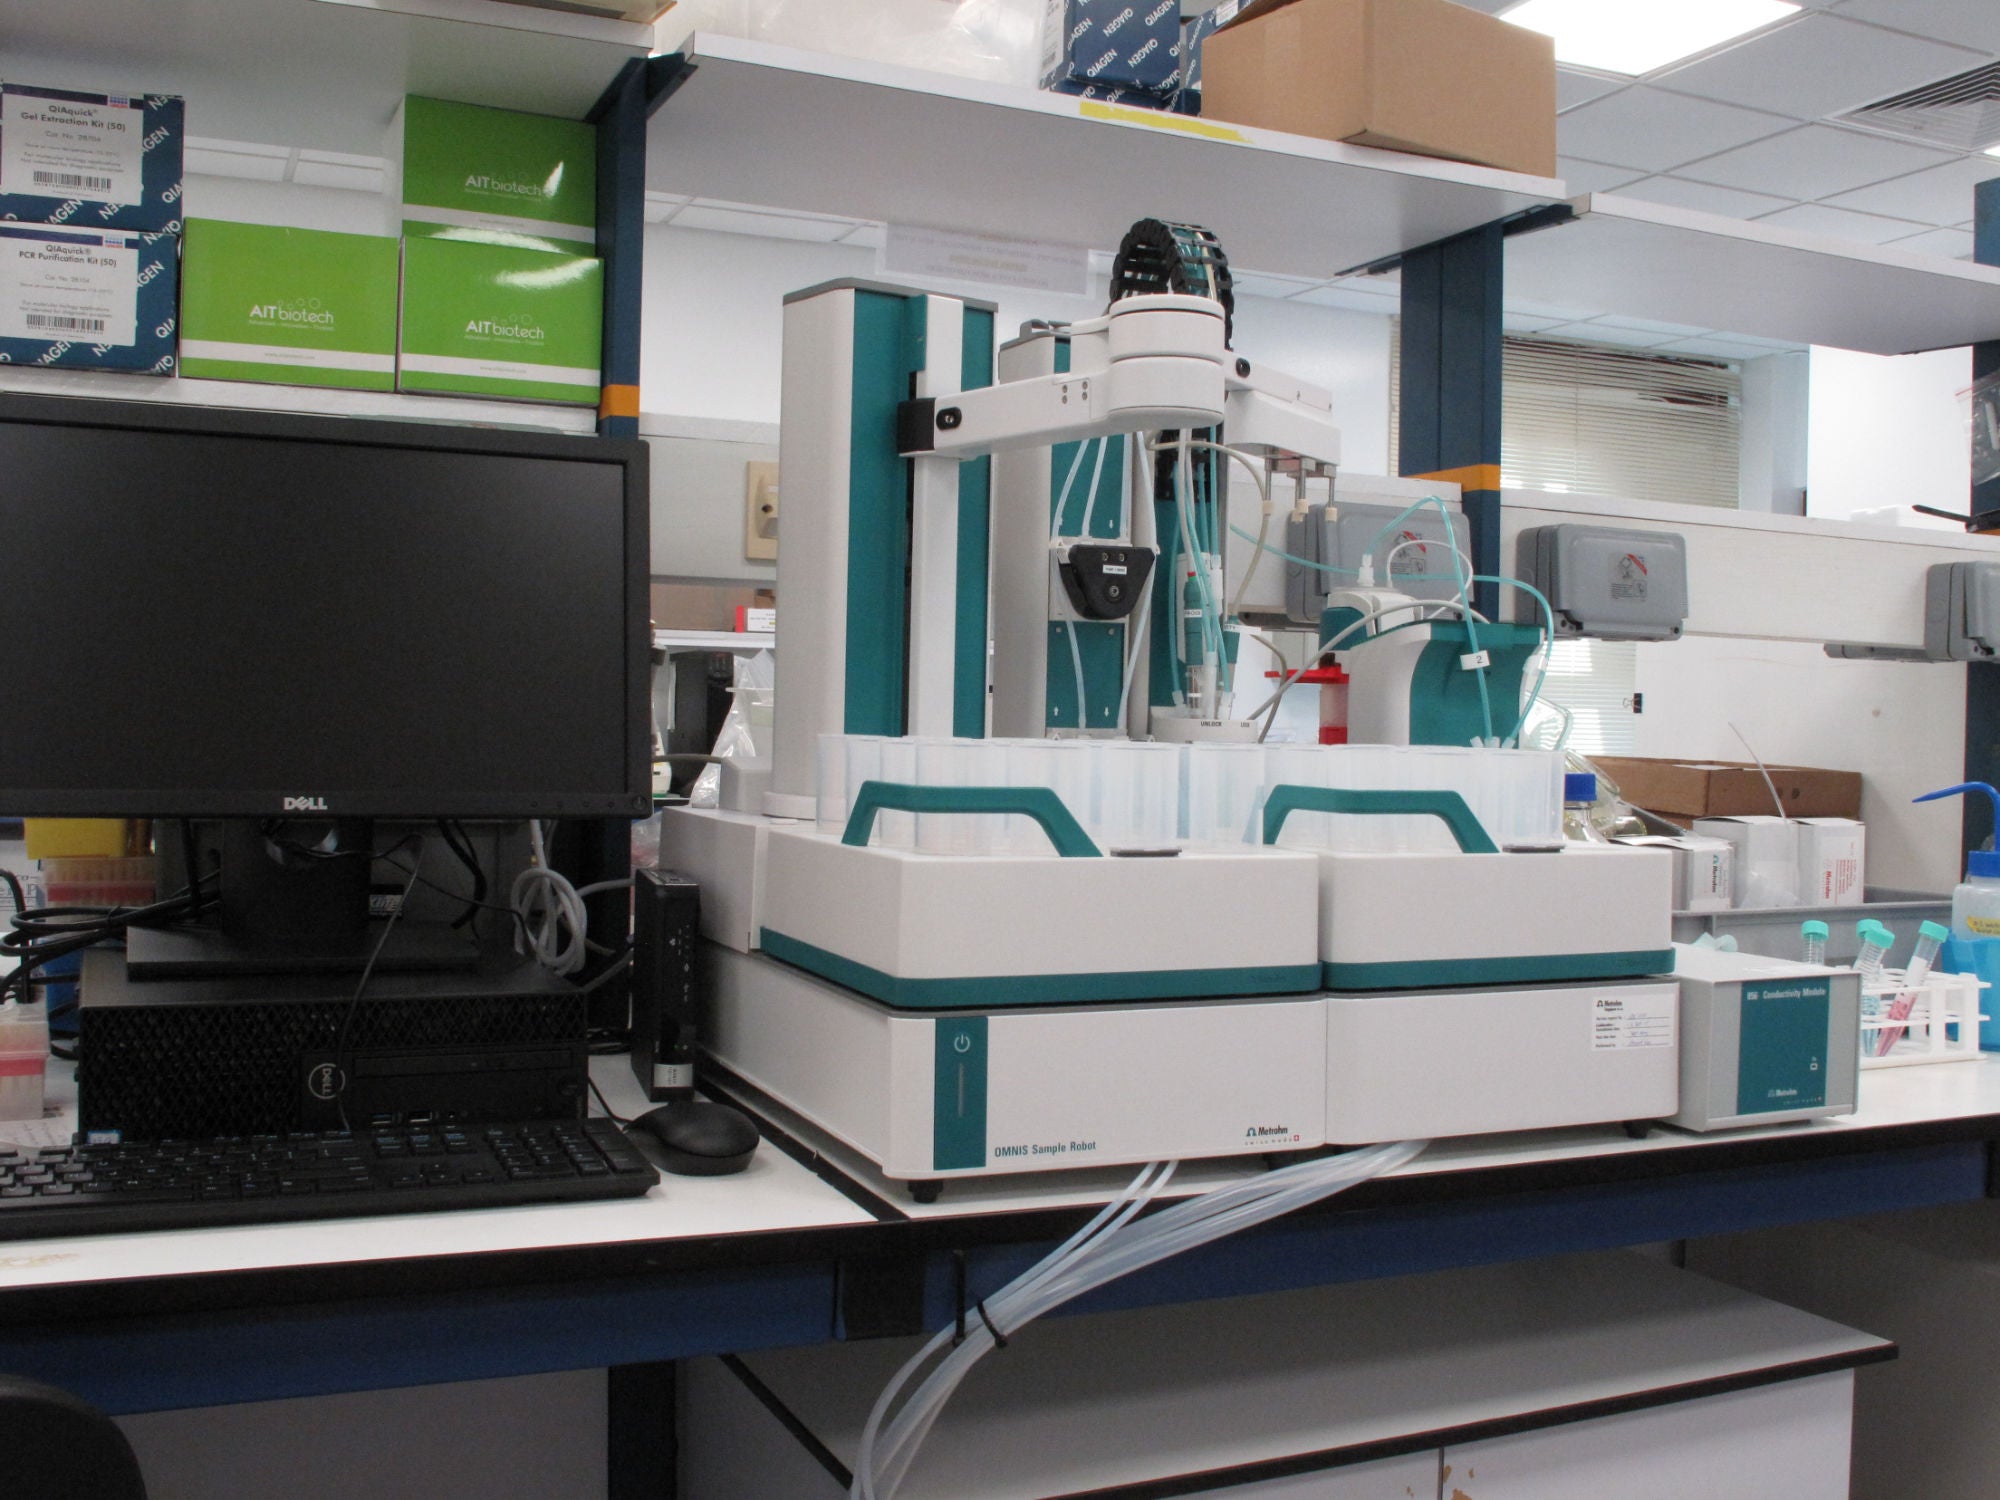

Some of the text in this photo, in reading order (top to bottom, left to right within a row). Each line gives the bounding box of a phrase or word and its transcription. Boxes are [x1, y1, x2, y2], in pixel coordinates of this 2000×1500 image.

[1103, 8, 1134, 37] QIAGEN
[1128, 38, 1158, 68] QIAGEN
[1086, 48, 1118, 78] QIAGEN
[21, 112, 126, 133] Gel Extraction Kit (50)
[19, 251, 117, 268] PCR Purification Kit (50)
[1475, 655, 1484, 664] 2
[1200, 720, 1222, 728] UNLOCK
[283, 796, 329, 811] DELL
[1258, 1125, 1288, 1136] Metrohm
[994, 1140, 1097, 1158] OMNIS Sample Robot
